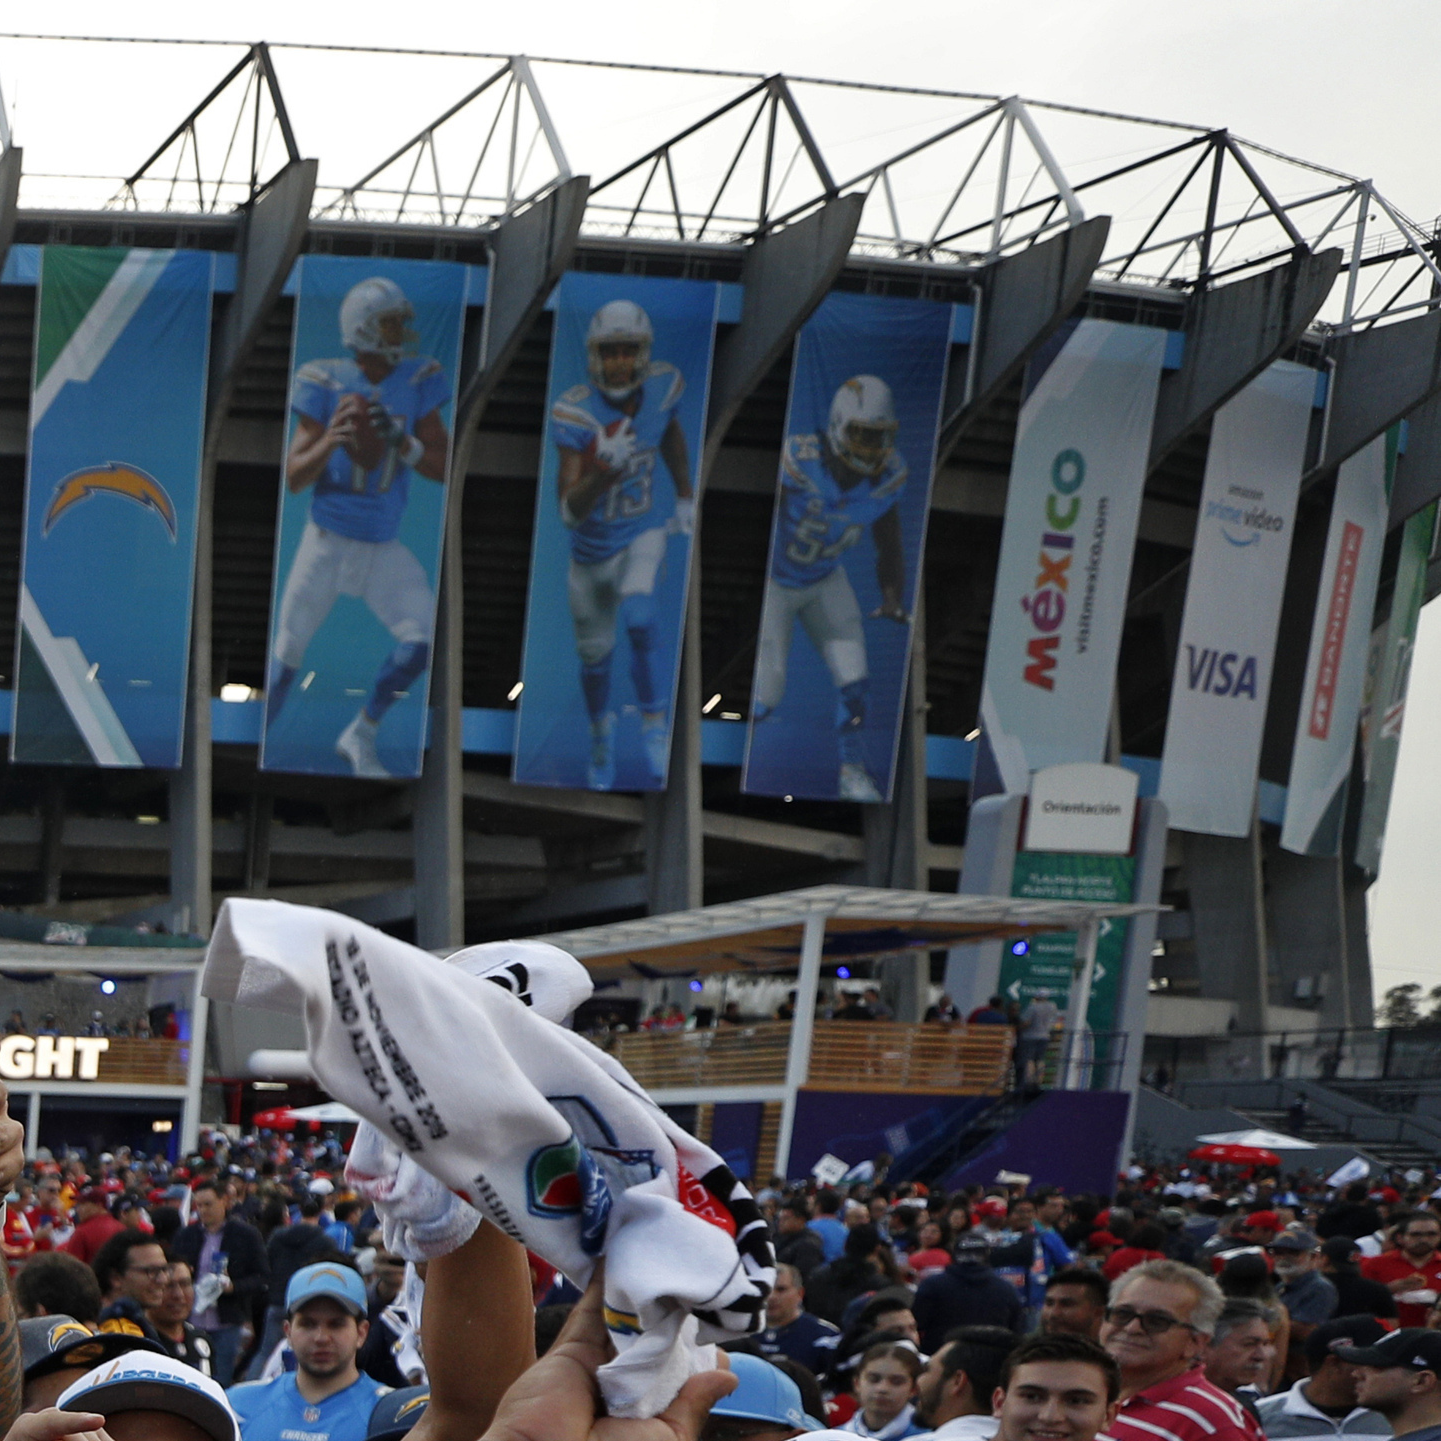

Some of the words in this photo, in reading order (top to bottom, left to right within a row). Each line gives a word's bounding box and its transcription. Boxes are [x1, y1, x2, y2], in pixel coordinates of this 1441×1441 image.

[1076, 496, 1109, 656] visitmexico.com
[1184, 643, 1259, 700] VISA
[1042, 799, 1122, 817] Orientación
[365, 989, 428, 1104] NOVIEMBRE
